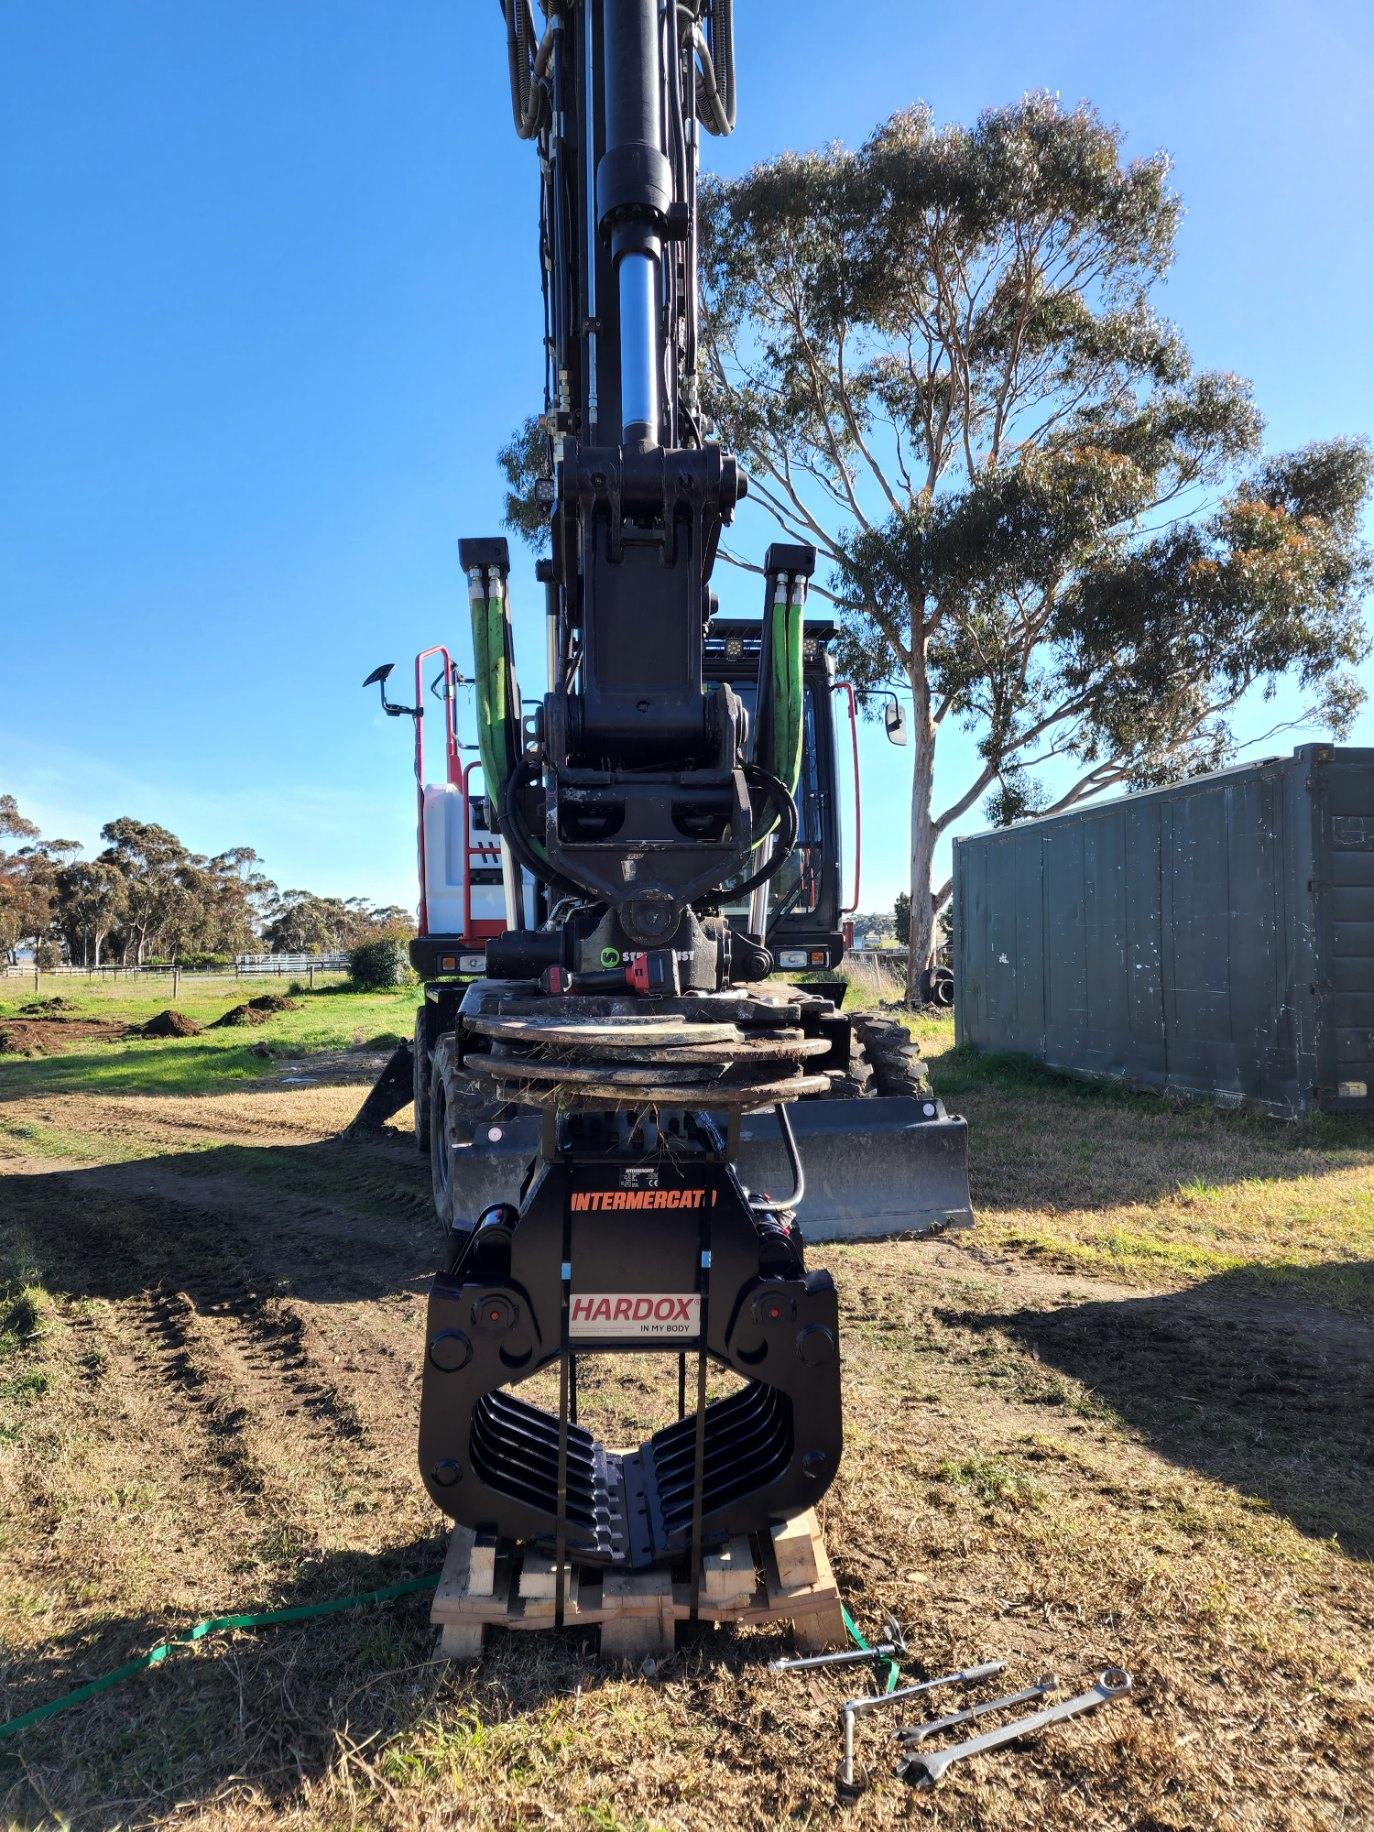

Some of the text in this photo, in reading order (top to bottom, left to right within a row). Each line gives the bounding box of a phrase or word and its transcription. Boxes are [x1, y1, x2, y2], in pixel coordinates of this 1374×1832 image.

[640, 1324, 650, 1332] IN
[651, 1324, 665, 1332] MY
[666, 1324, 690, 1332] BODY
